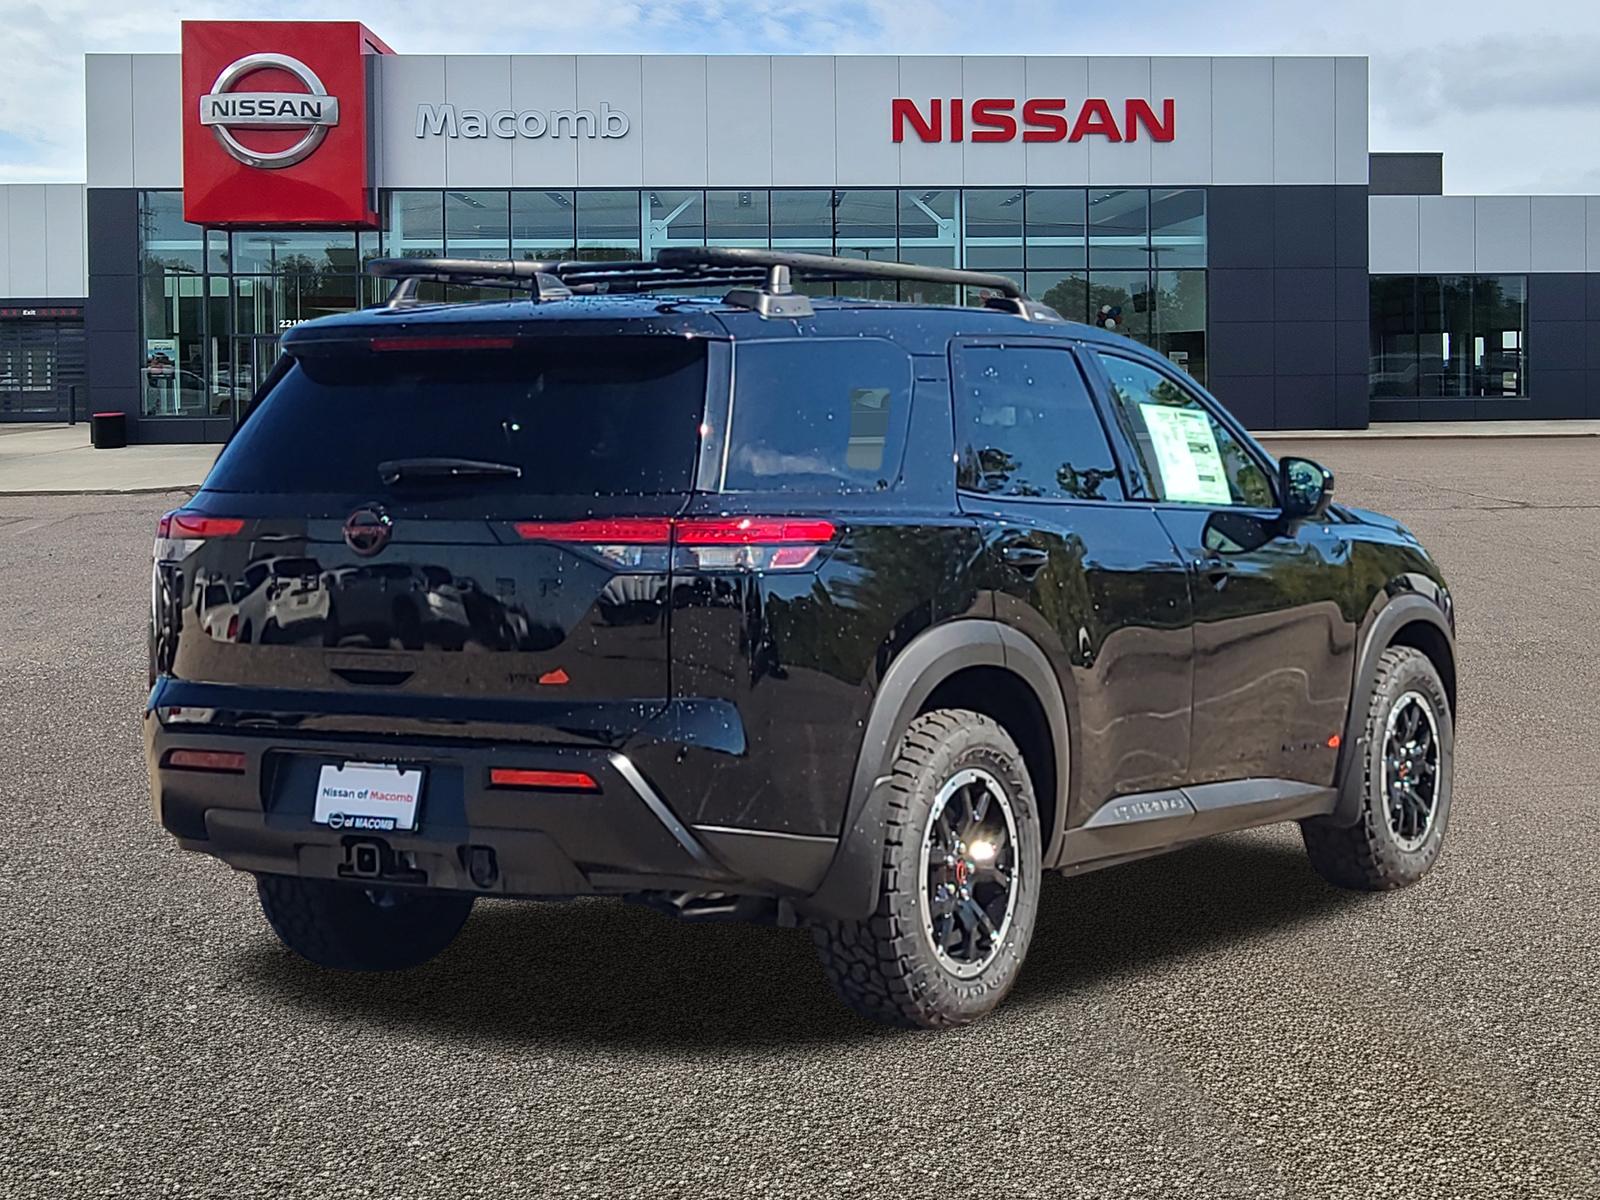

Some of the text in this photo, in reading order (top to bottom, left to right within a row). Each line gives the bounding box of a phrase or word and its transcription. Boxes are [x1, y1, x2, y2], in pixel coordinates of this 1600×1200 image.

[211, 99, 322, 118] NISSAN
[415, 101, 630, 139] Macomb
[891, 98, 1176, 143] NISSAN
[22, 308, 37, 316] Exit
[322, 787, 414, 803] Nissan of Macomb
